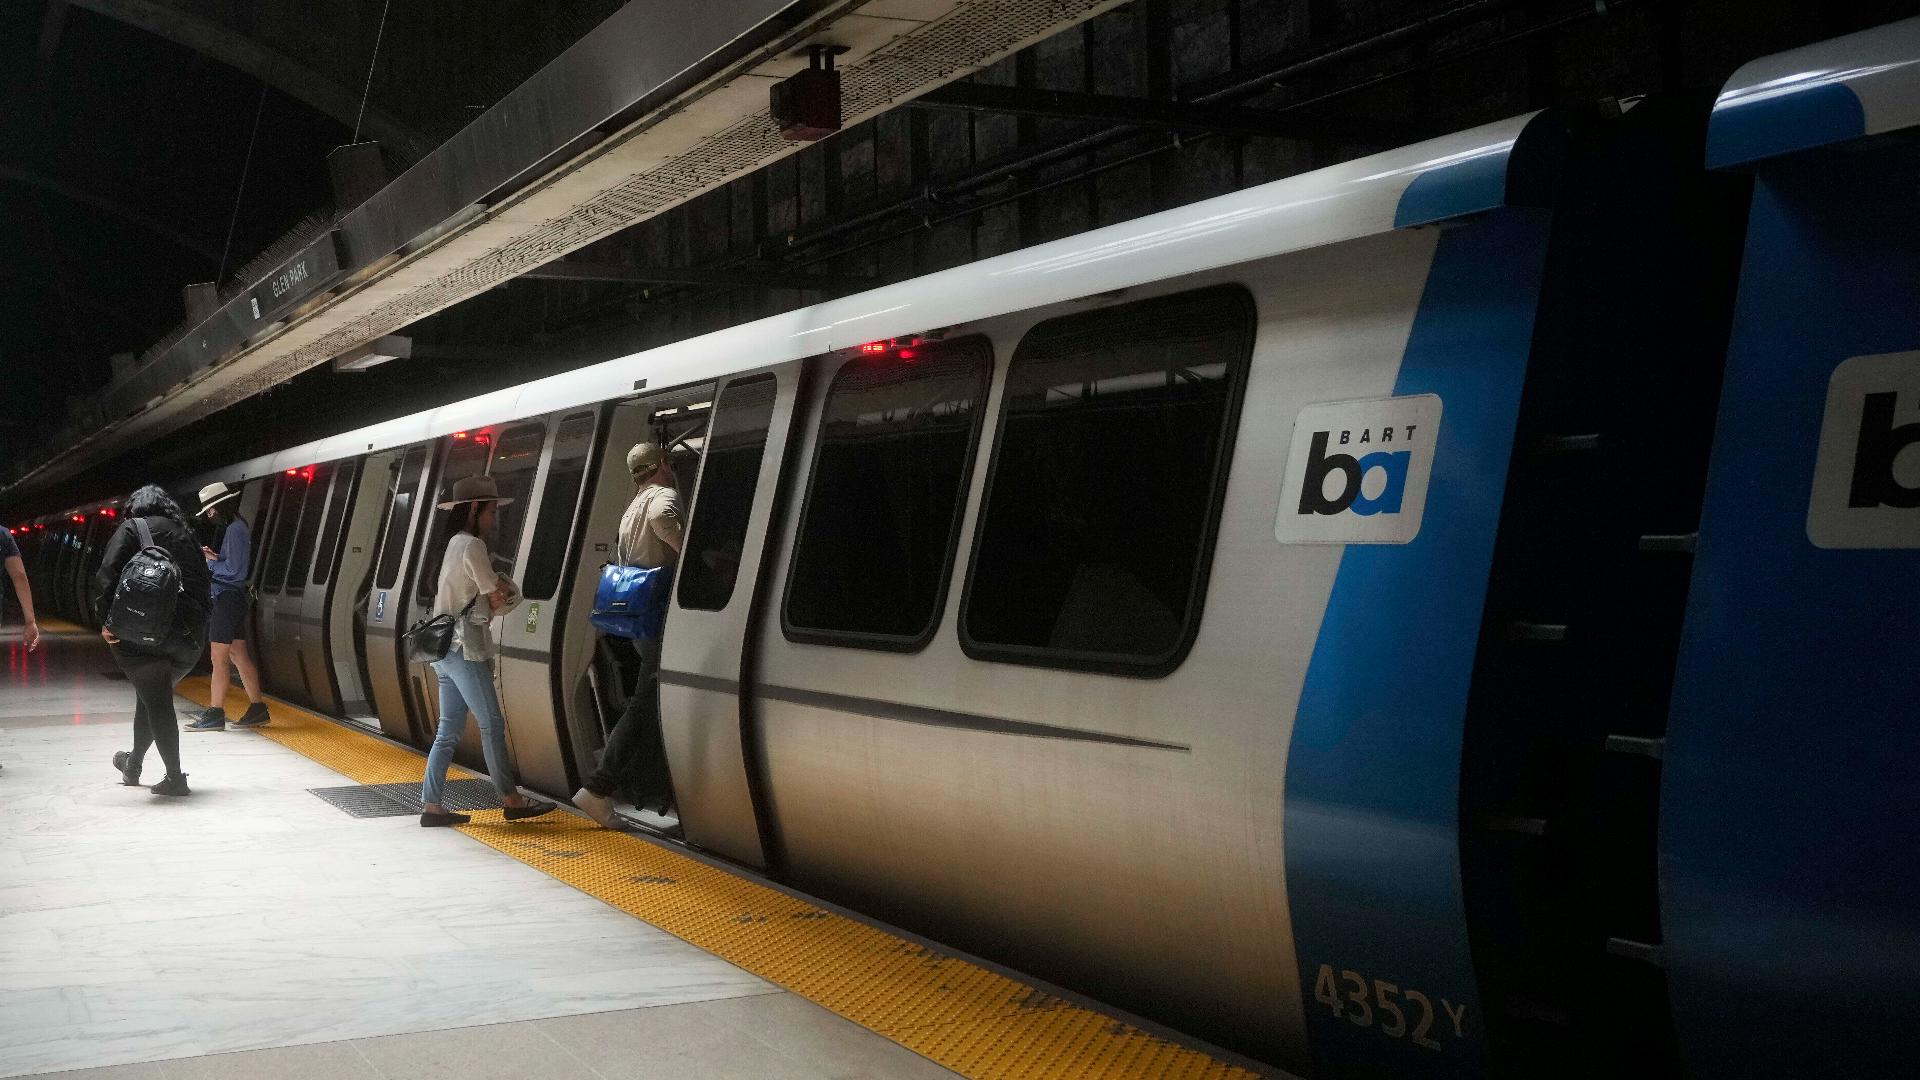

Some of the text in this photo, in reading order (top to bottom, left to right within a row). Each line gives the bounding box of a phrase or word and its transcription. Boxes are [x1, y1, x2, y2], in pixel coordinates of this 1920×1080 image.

[272, 260, 309, 298] GLEN PARK
[1339, 425, 1417, 445] BART
[1297, 430, 1412, 516] ba
